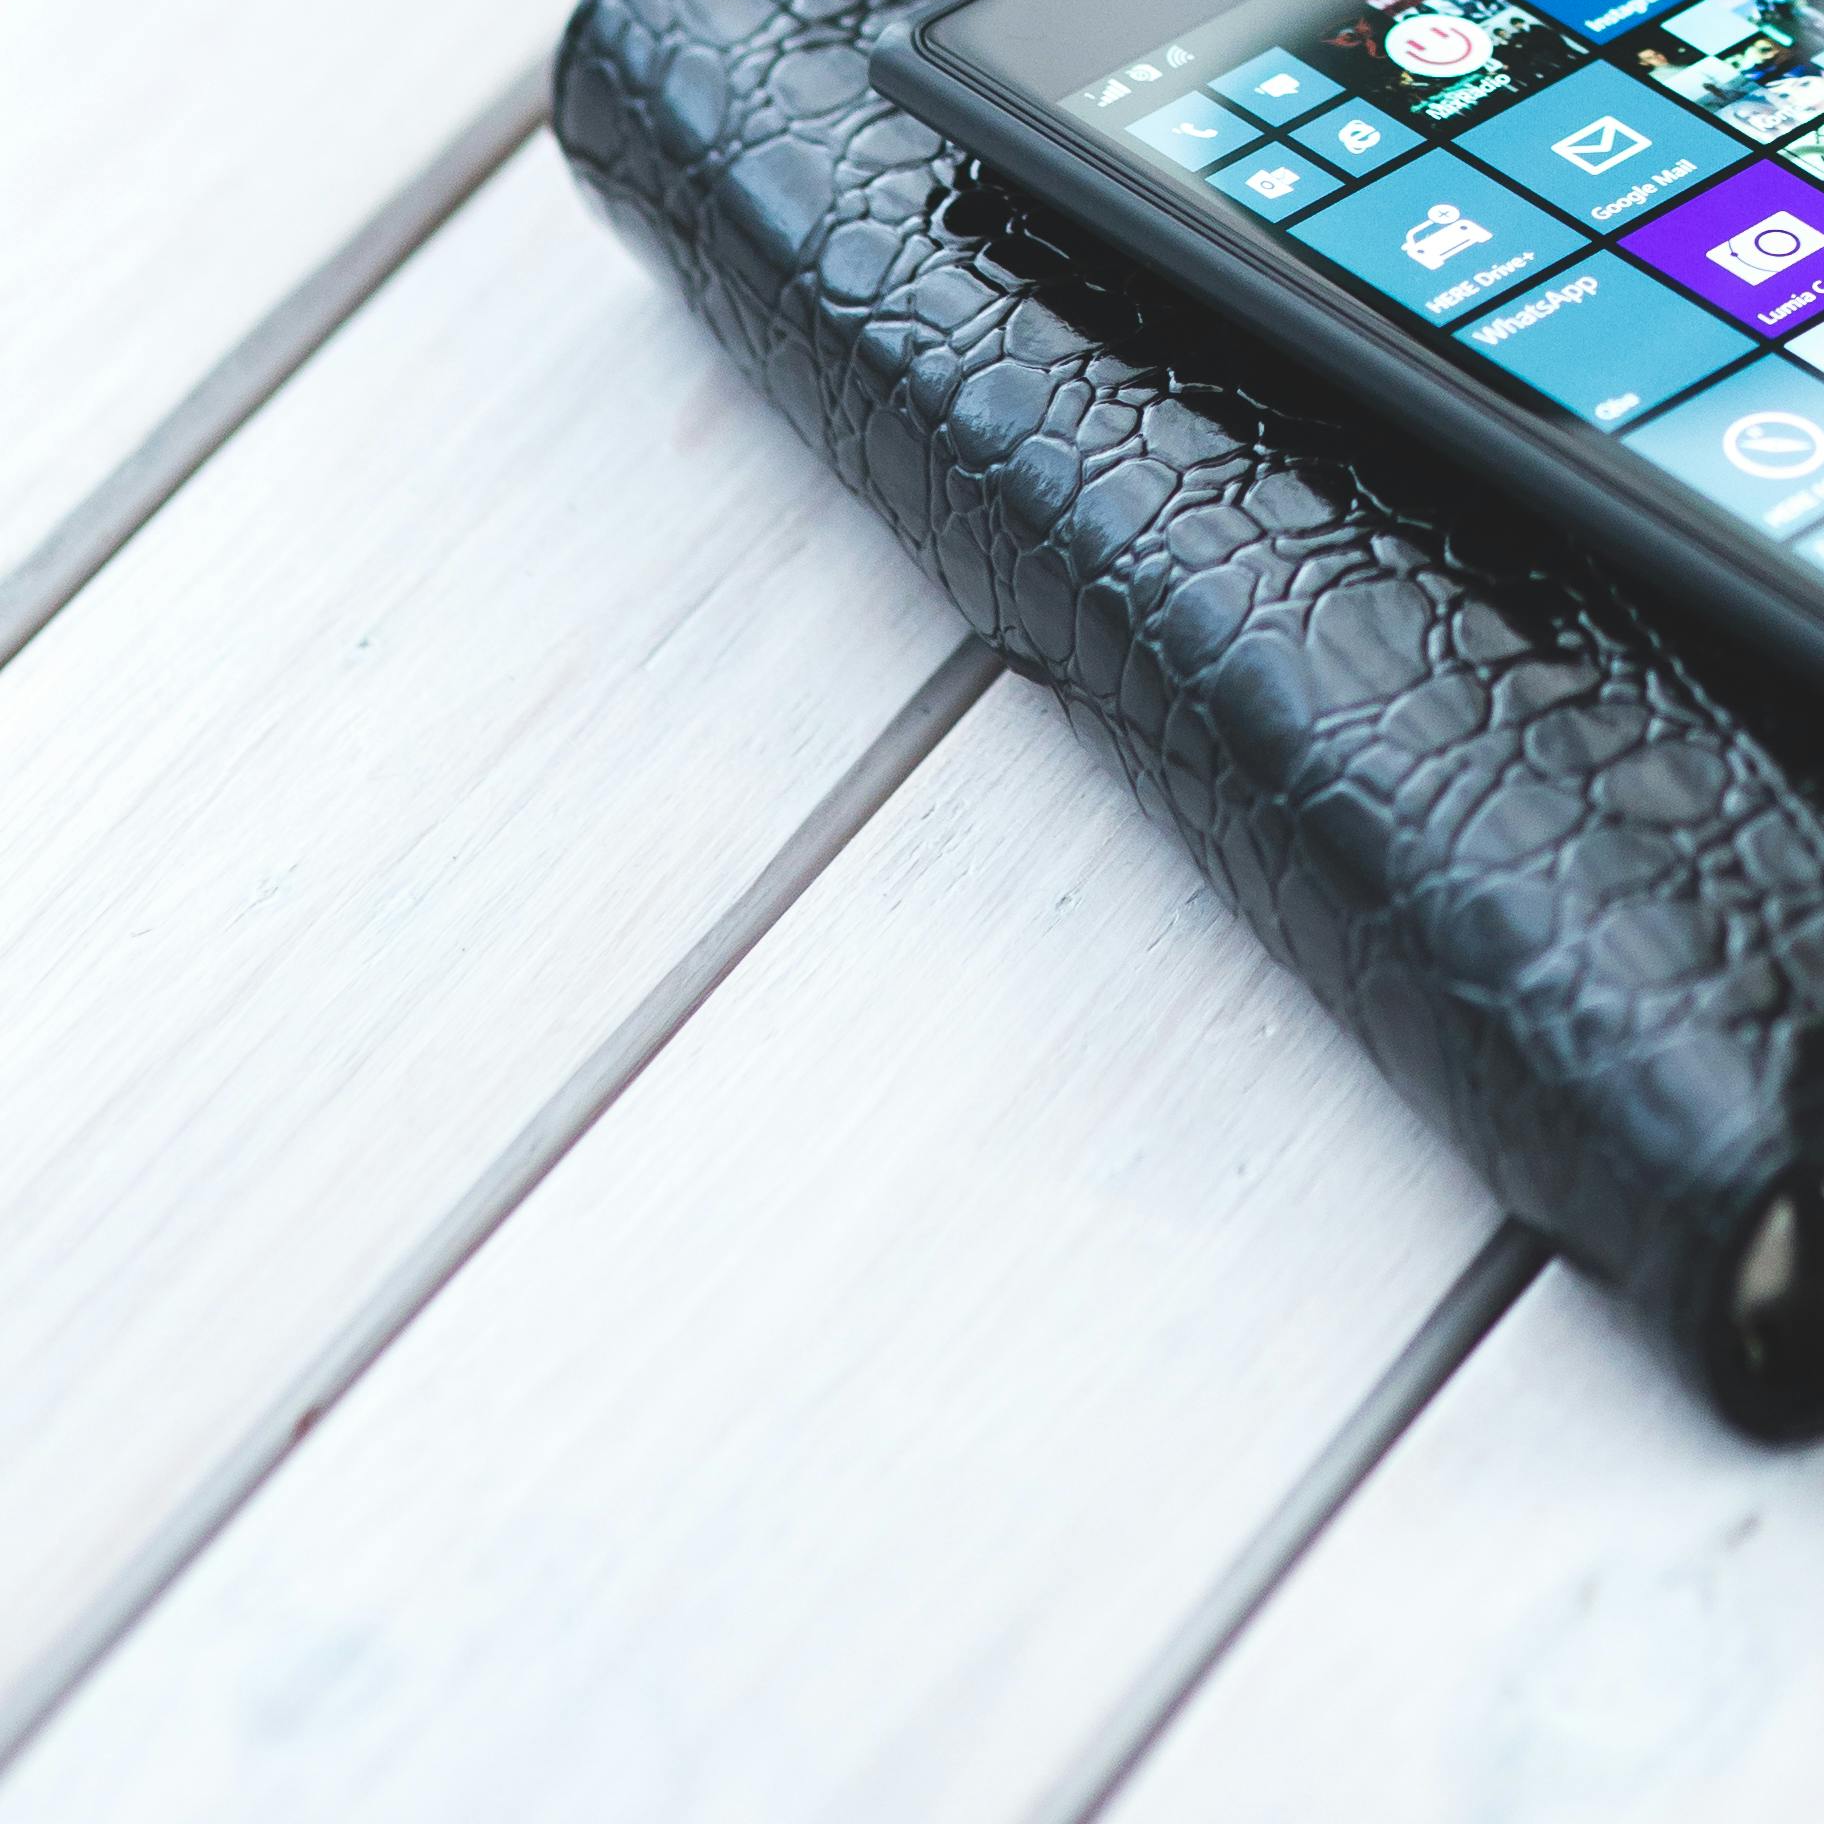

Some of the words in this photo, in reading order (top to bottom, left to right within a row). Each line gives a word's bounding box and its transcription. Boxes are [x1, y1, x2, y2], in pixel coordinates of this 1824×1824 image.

[1591, 183, 1658, 220] Google
[1651, 158, 1698, 187] Mail
[1425, 280, 1480, 314] HERE
[1473, 251, 1535, 287] Drive+
[1471, 275, 1599, 345] WhatsApp
[1757, 291, 1817, 325] Lumia
